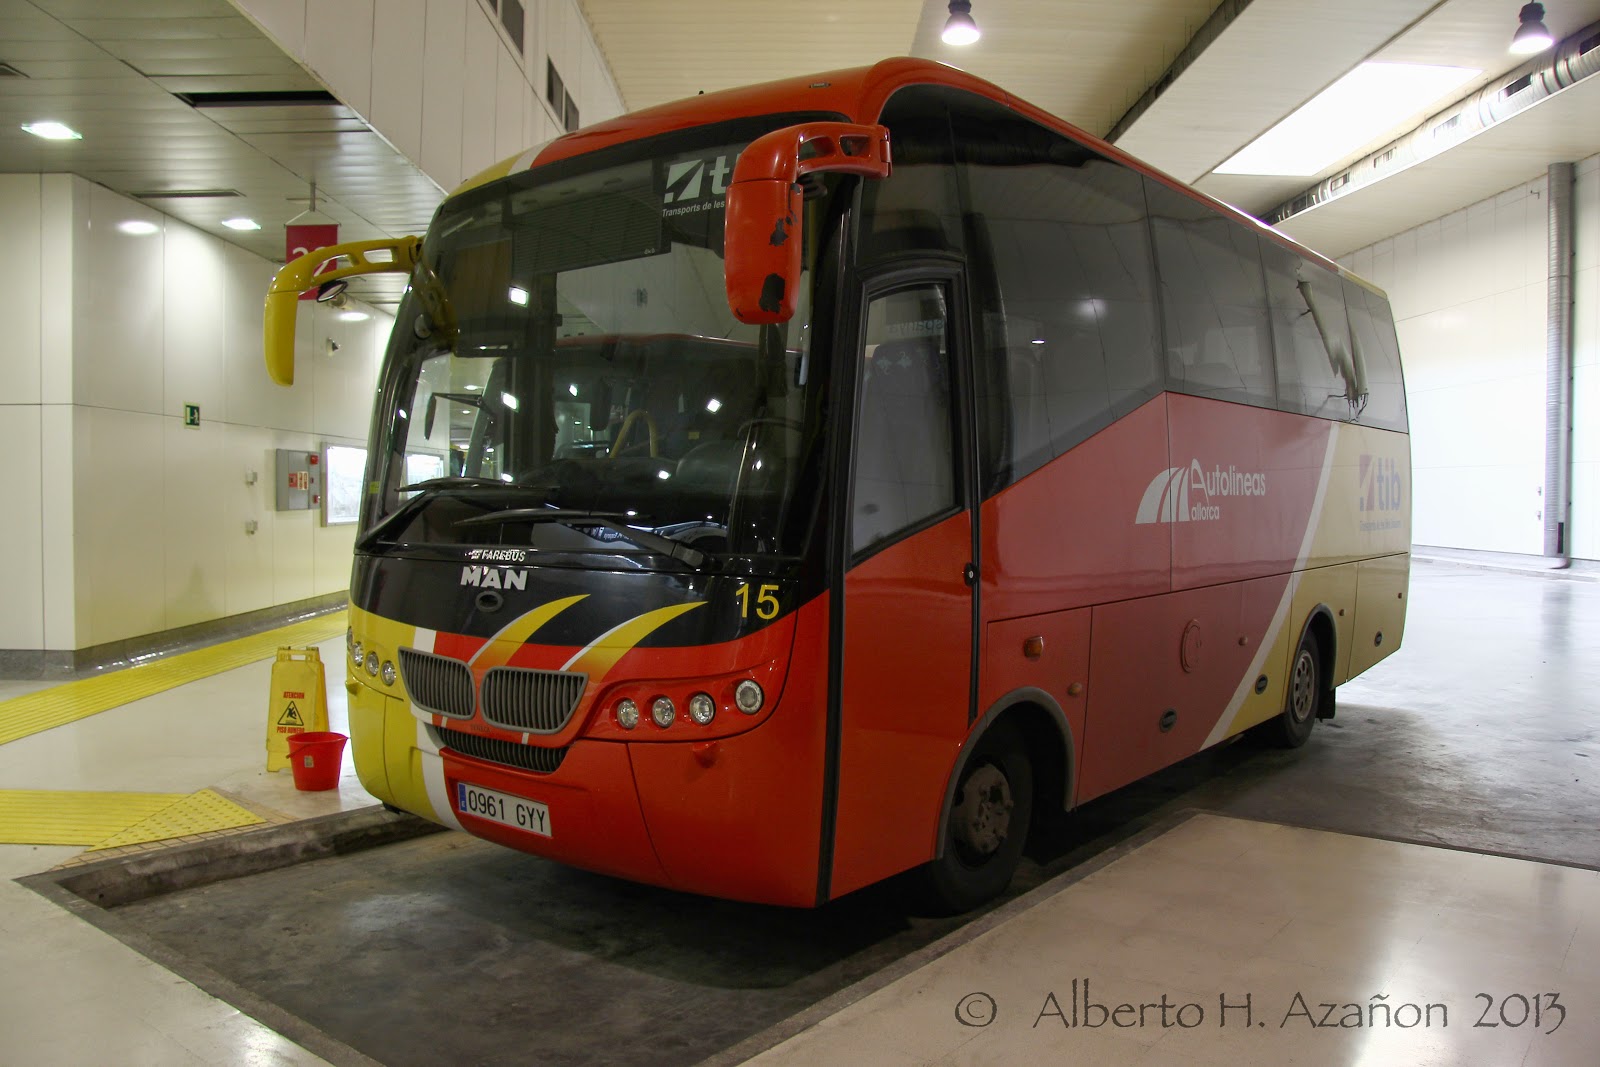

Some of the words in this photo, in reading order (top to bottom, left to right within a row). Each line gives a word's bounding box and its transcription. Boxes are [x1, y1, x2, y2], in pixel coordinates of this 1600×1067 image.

[662, 204, 700, 217] Transports
[702, 202, 712, 211] de
[713, 201, 725, 209] les
[1190, 458, 1266, 506] Autolineas
[1376, 457, 1401, 511] tib
[481, 549, 526, 562] FAREBUS
[460, 566, 528, 591] MAN
[735, 583, 780, 620] 15
[468, 790, 505, 820] 0961
[516, 804, 545, 832] GYY
